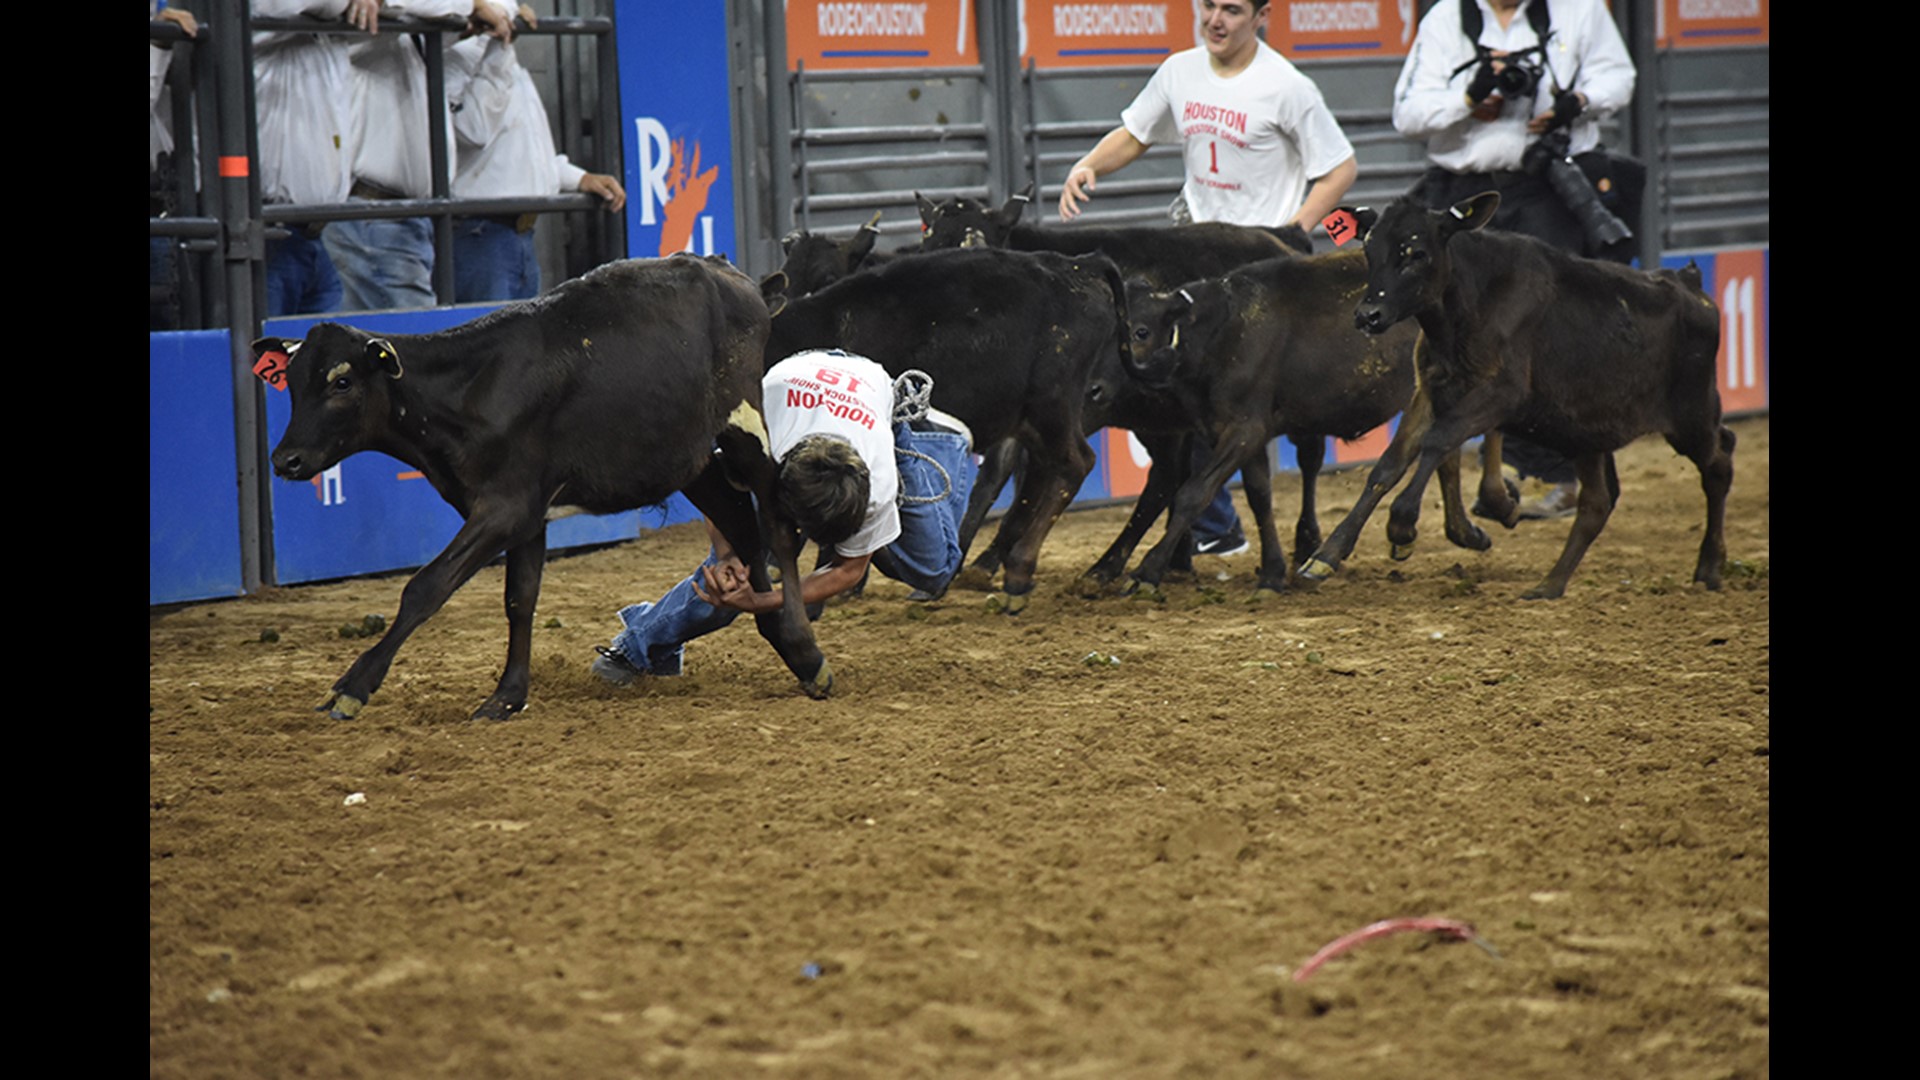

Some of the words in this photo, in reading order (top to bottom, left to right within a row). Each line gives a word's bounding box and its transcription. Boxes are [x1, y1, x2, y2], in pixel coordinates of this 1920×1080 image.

[817, 3, 927, 36] RODEOHOUSTON
[1053, 4, 1168, 36] RODEOHOUSTON
[1183, 101, 1248, 134] HOUSTON
[1209, 141, 1219, 174] 1
[1326, 216, 1349, 240] 31
[1724, 276, 1756, 390] 11
[259, 358, 287, 385] 26
